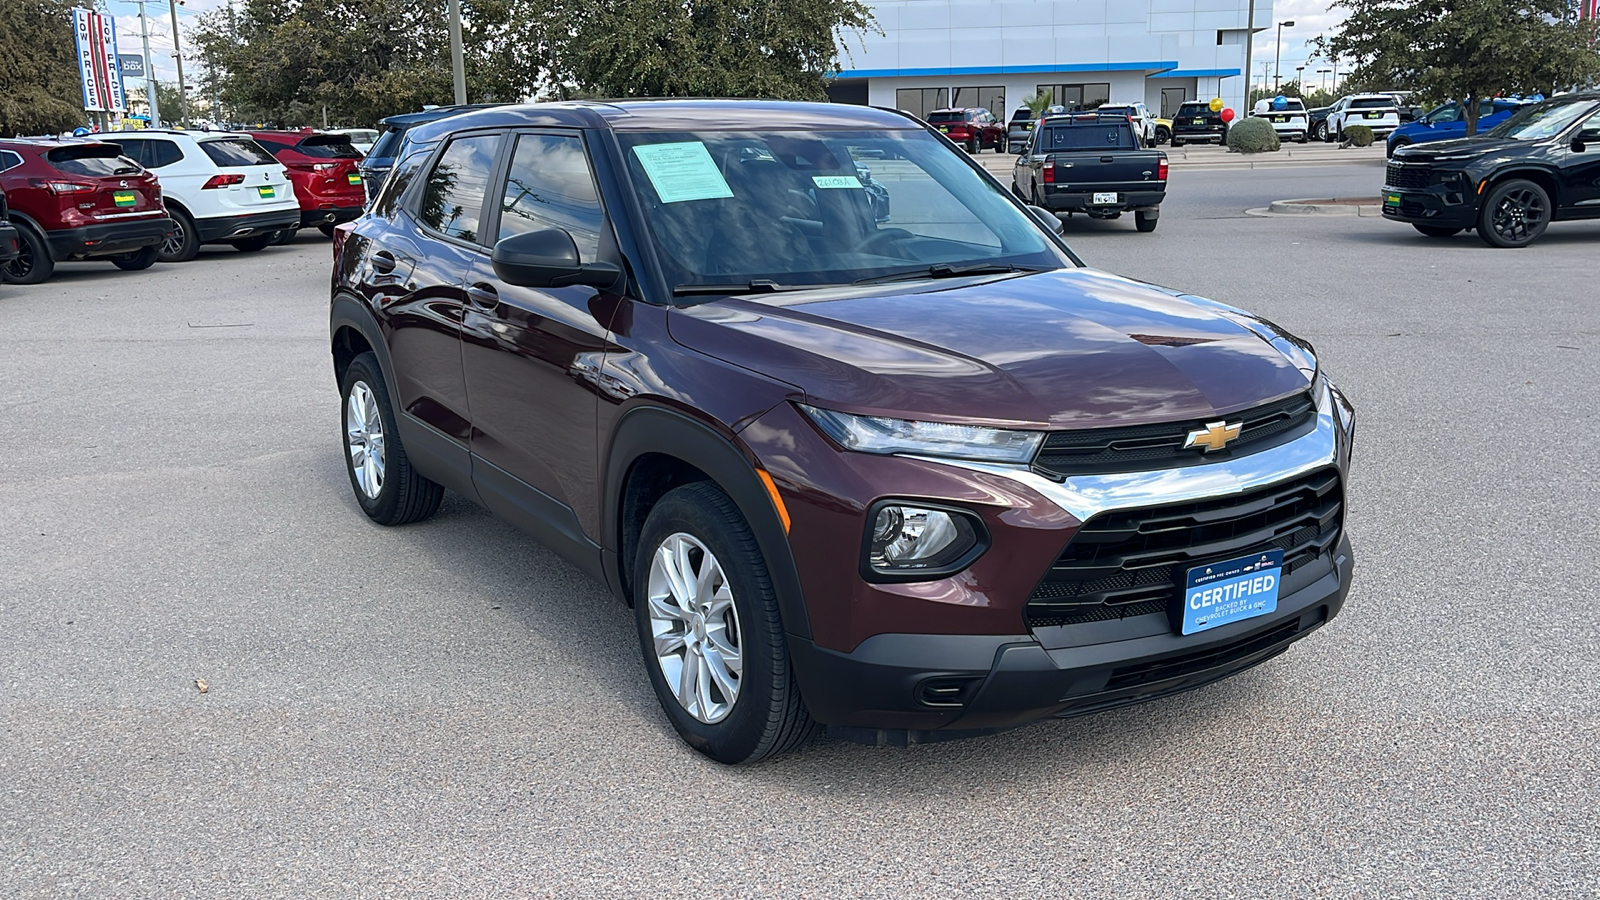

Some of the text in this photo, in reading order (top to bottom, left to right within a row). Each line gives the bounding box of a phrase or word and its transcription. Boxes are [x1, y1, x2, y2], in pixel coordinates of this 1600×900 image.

[79, 13, 96, 106] LOW PRICES
[123, 62, 142, 70] box
[107, 54, 120, 107] PRICES
[1195, 574, 1216, 583] CERTIFIED
[1190, 575, 1275, 610] CERTIFIED
[1194, 610, 1229, 624] CHEVROLET
[1230, 605, 1248, 615] BUICK
[1253, 600, 1267, 609] GMC
[1215, 601, 1239, 612] BACKED
